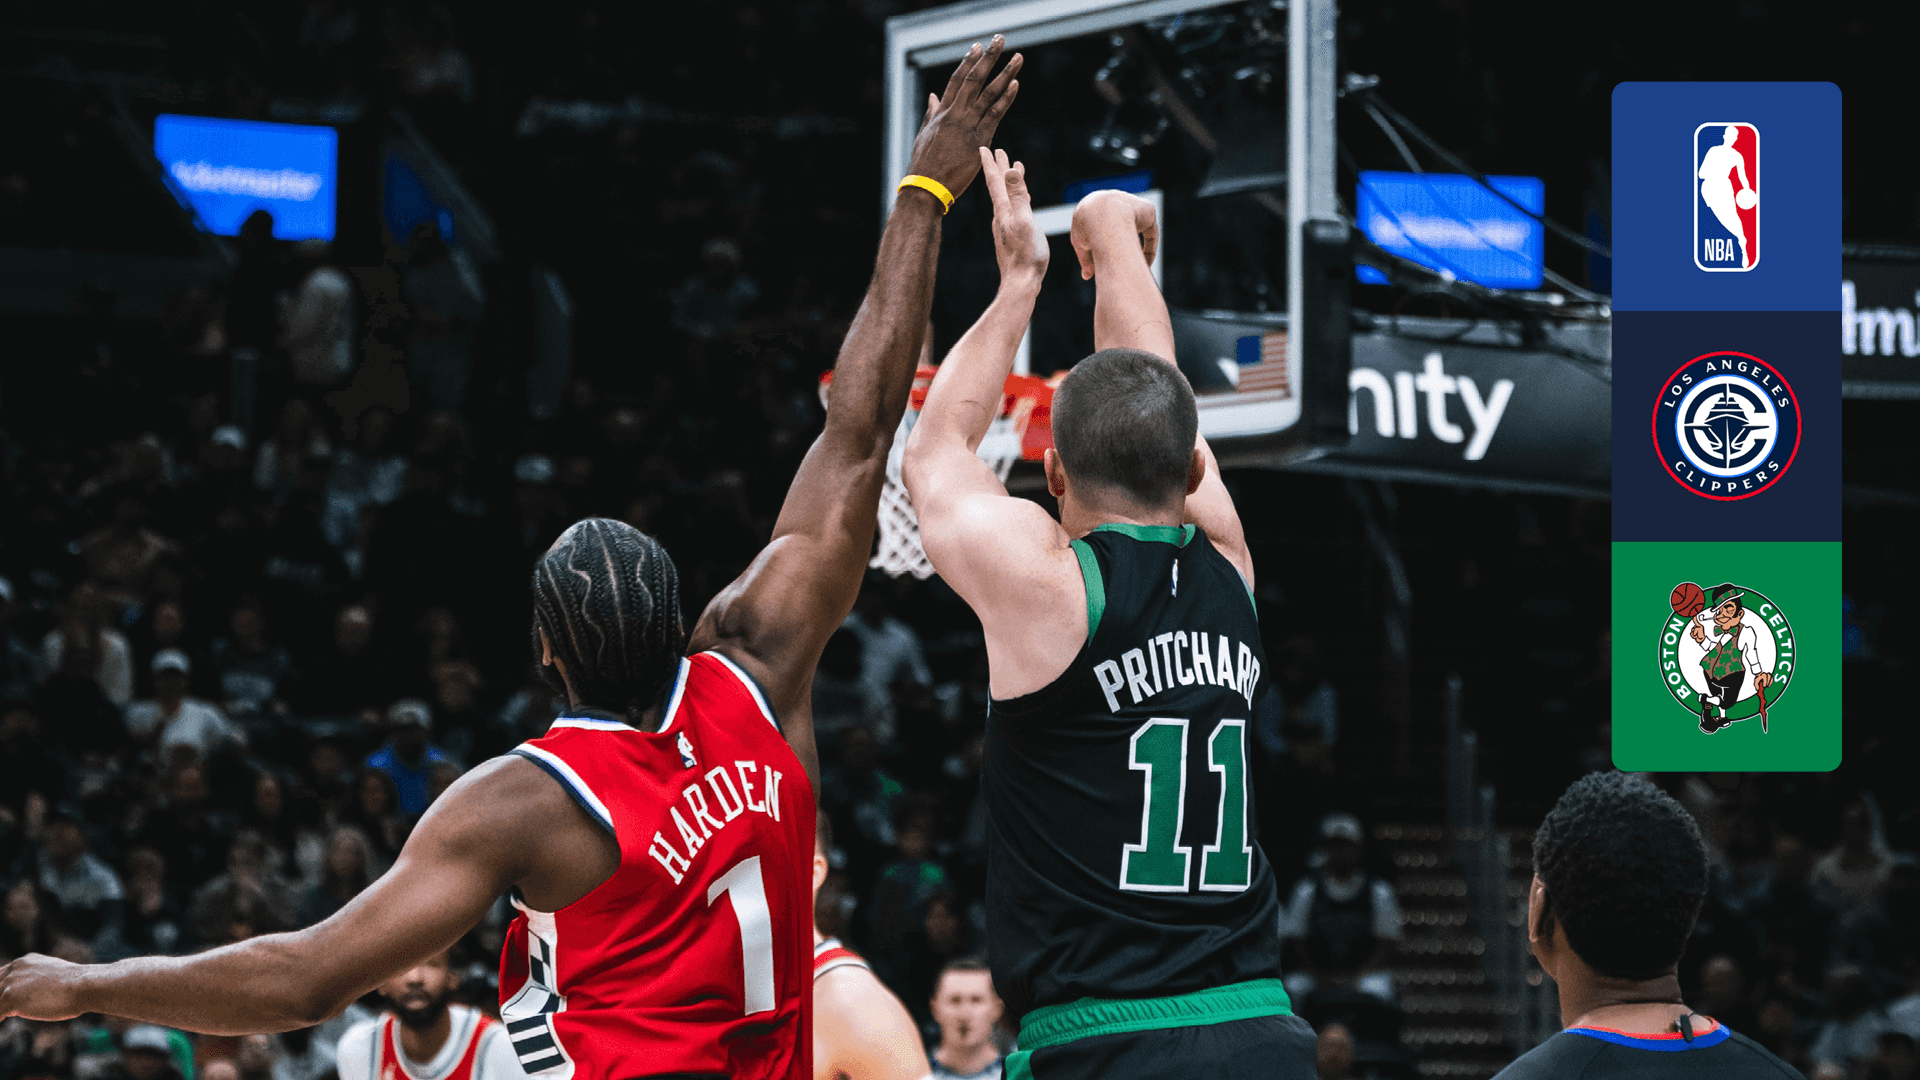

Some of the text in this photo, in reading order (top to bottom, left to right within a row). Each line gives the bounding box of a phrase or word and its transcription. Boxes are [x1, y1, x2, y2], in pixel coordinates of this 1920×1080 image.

[1093, 630, 1261, 713] PRITCHARD
[648, 760, 783, 885] HARDEN
[1118, 717, 1253, 893] 11
[707, 855, 776, 1016] 1
